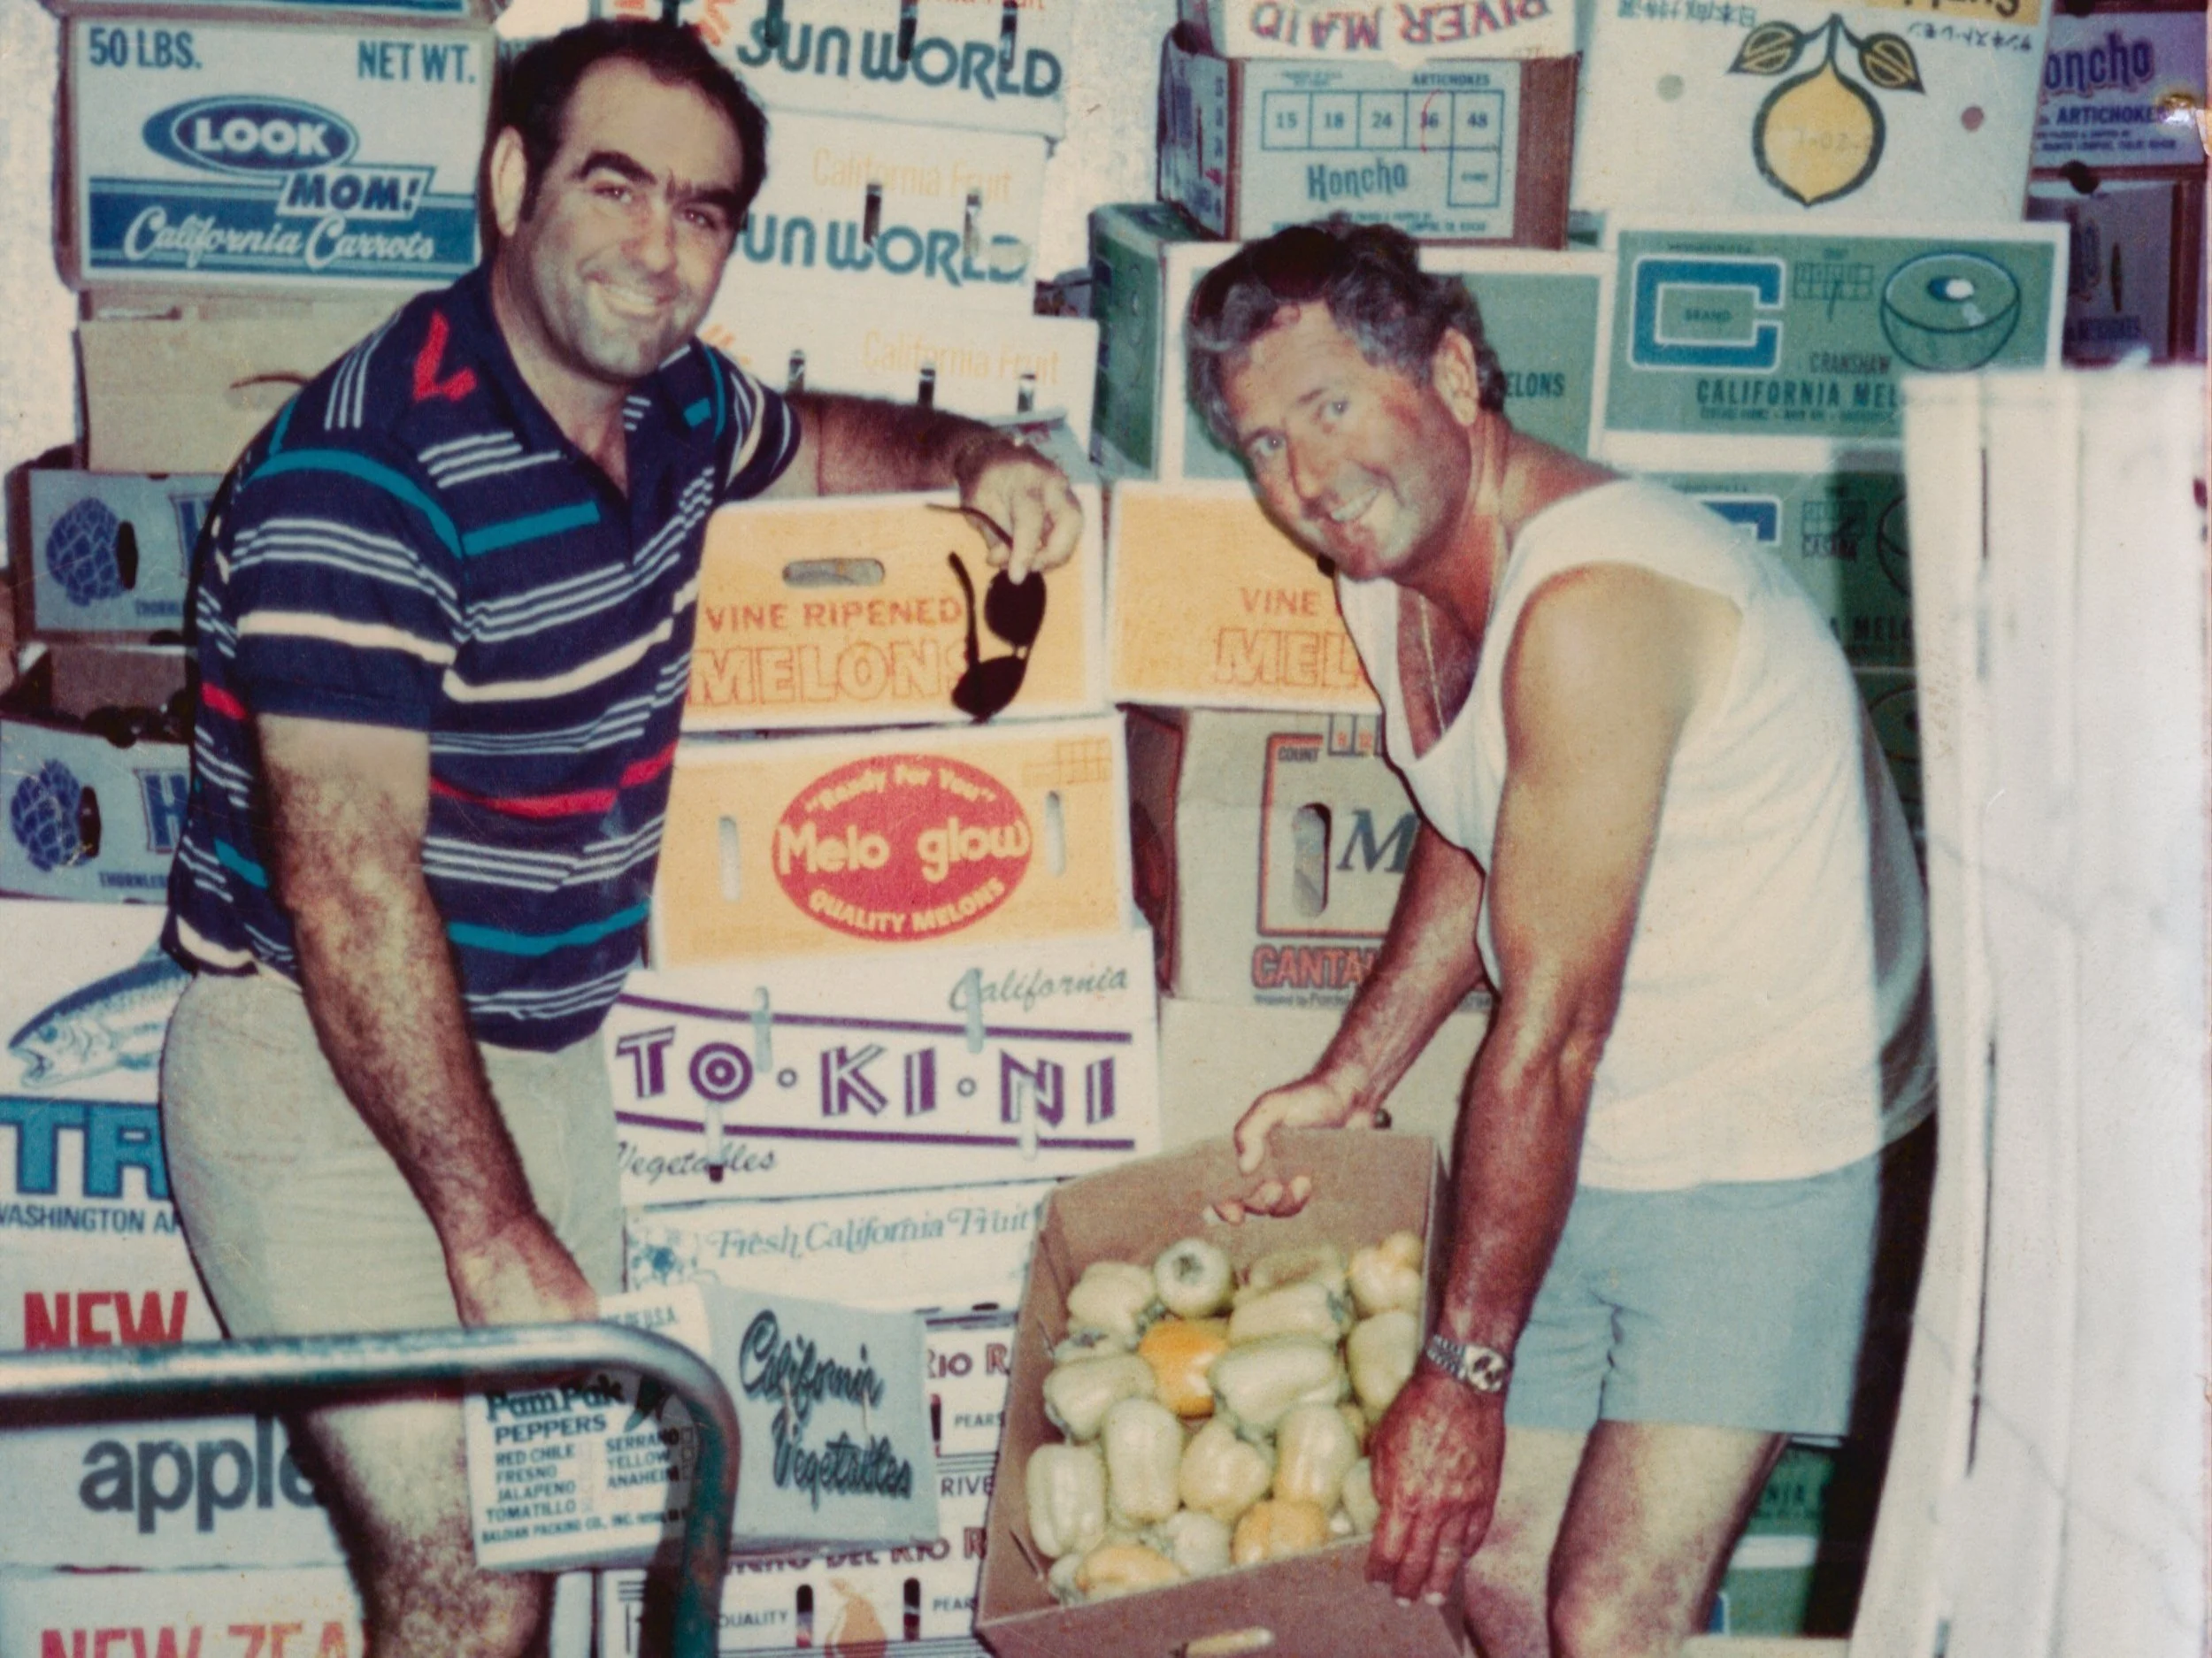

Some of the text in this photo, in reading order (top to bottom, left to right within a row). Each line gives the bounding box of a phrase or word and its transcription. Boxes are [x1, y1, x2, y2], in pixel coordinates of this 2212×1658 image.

[1250, 3, 1382, 50] MAID
[89, 27, 476, 84] 50 LBS. NET WT.
[1412, 73, 1492, 87] ARTICHOKES
[193, 116, 331, 158] LOOK
[1277, 111, 1298, 129] 15
[1325, 111, 1345, 129] 18
[1372, 111, 1393, 129] 24
[1467, 112, 1488, 129] 48
[285, 172, 420, 212] MOM!
[811, 146, 1014, 203] California Fruit
[1305, 155, 1409, 202] Honcho
[123, 205, 435, 273] California Carrots
[736, 212, 818, 266] UN
[863, 326, 1062, 387] California Fruit
[1696, 378, 1840, 407] CALIFORNIA
[705, 595, 964, 633] VINE RIPENED
[1240, 587, 1319, 617] VINE
[1278, 746, 1320, 764] COUNT
[778, 815, 1031, 884] Melo glow
[808, 876, 1006, 933] QUALITY MELONS
[948, 967, 1130, 1013] California
[708, 1205, 1031, 1260] Fresh California Fruit
[740, 1309, 886, 1424] California
[495, 1414, 607, 1446] PEPPERS
[606, 1427, 680, 1453] SERRANO
[495, 1443, 575, 1468] RED CHILE
[495, 1465, 558, 1485] FRESNO
[607, 1449, 672, 1470] YELLOW
[772, 1404, 915, 1509] Vegetables
[497, 1480, 577, 1503] JALAPENO
[607, 1464, 680, 1489] ANAHEIM
[486, 1500, 577, 1524] TOMATILLO
[533, 1517, 581, 1536] PACKING
